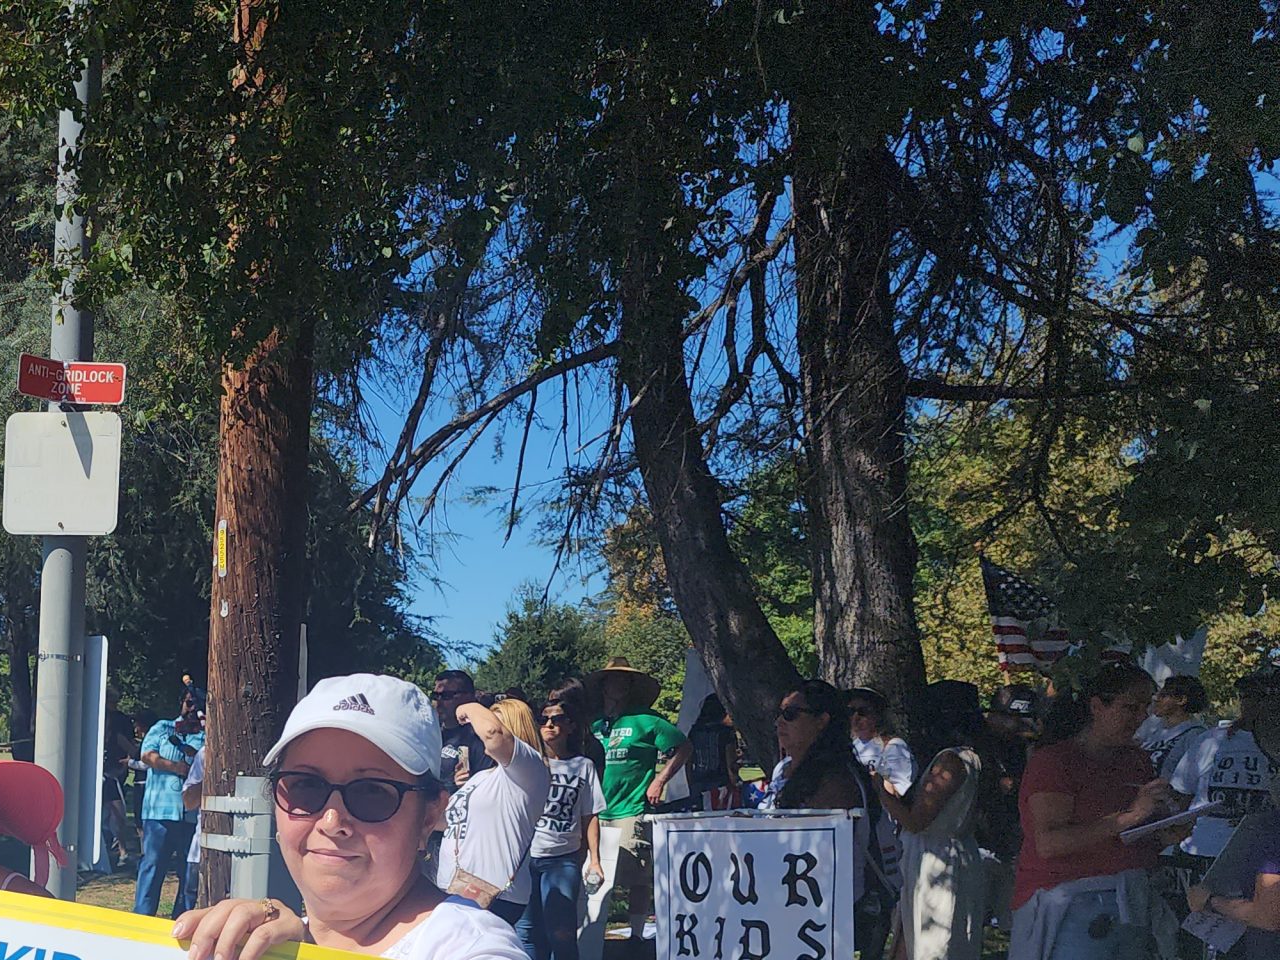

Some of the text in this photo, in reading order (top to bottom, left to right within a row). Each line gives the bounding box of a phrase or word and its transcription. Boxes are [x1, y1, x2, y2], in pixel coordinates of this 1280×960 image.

[28, 363, 114, 383] ANTI-GRIDLOCK
[51, 381, 82, 395] ZONE
[333, 704, 375, 716] adidas
[678, 851, 824, 908] OUR
